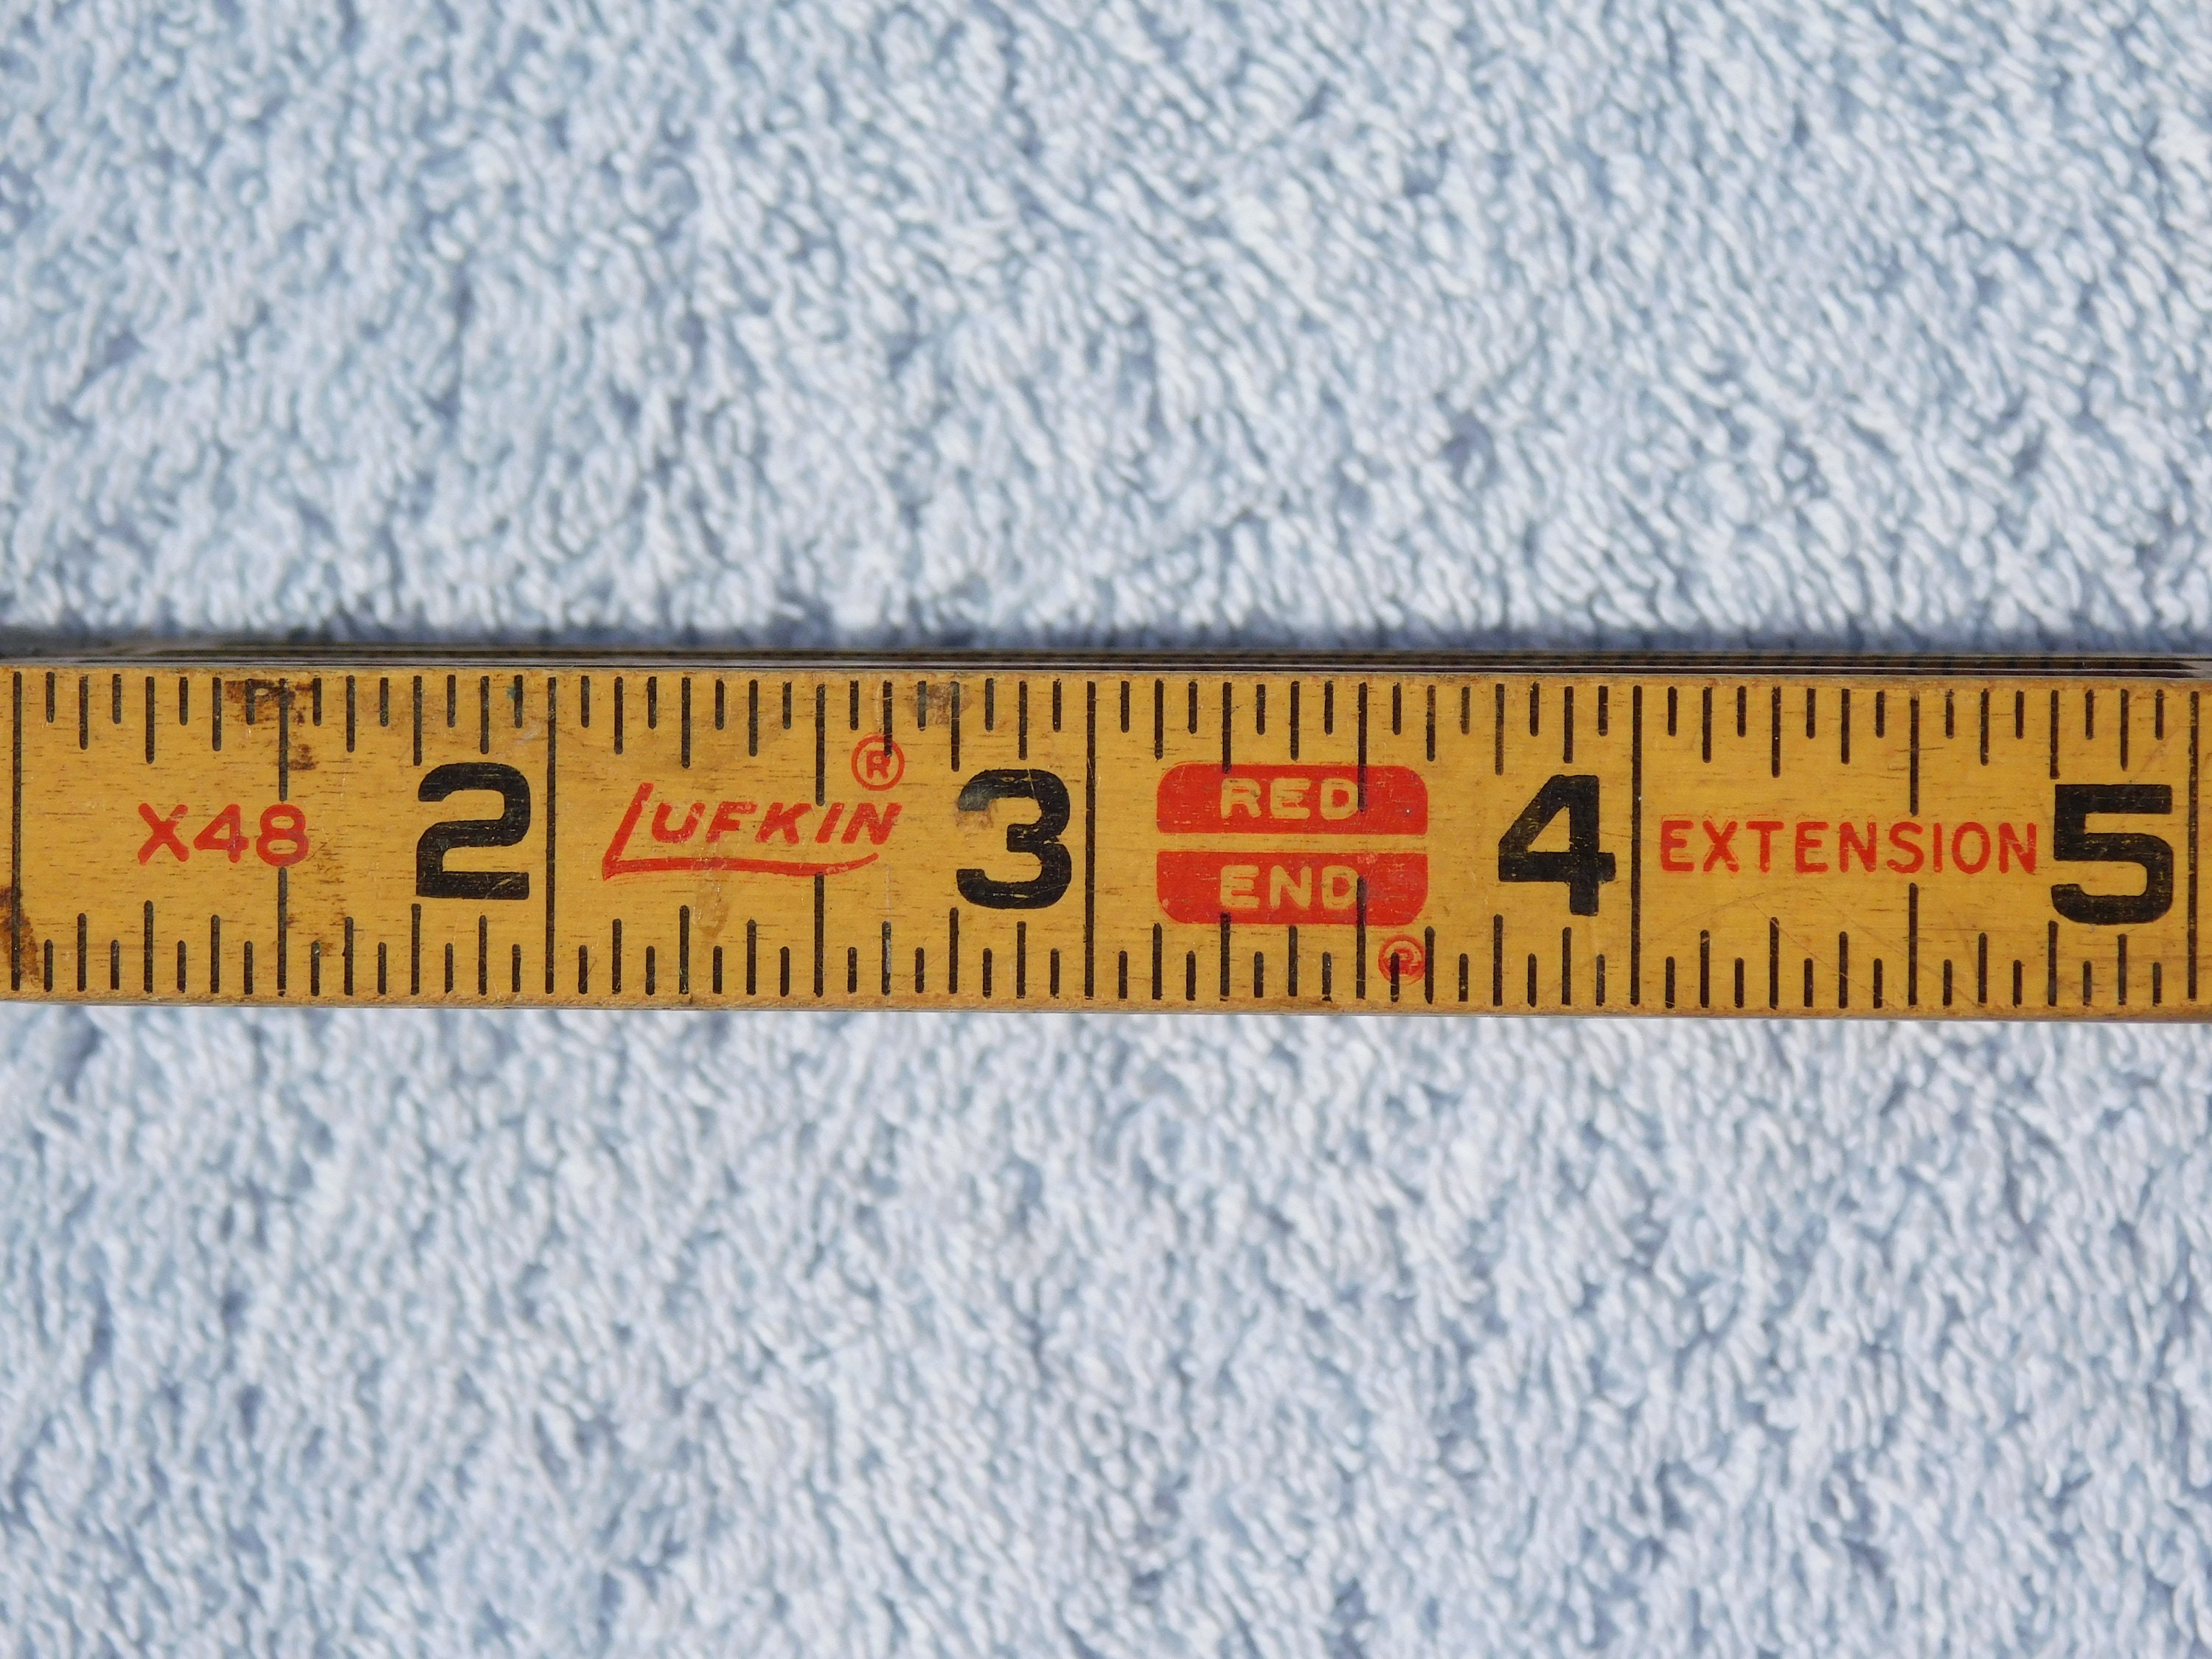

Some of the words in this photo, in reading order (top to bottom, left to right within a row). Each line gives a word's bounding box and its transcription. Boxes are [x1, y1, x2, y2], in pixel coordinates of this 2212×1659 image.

[138, 803, 310, 867] X48
[416, 762, 532, 900] 2
[602, 782, 902, 880] LUFKIN
[956, 768, 1072, 910] 3
[1220, 777, 1362, 821] RED
[1498, 774, 1616, 917] 4
[1660, 820, 2038, 874] EXTENSION
[1220, 864, 1362, 910] END
[2051, 783, 2174, 925] 5
